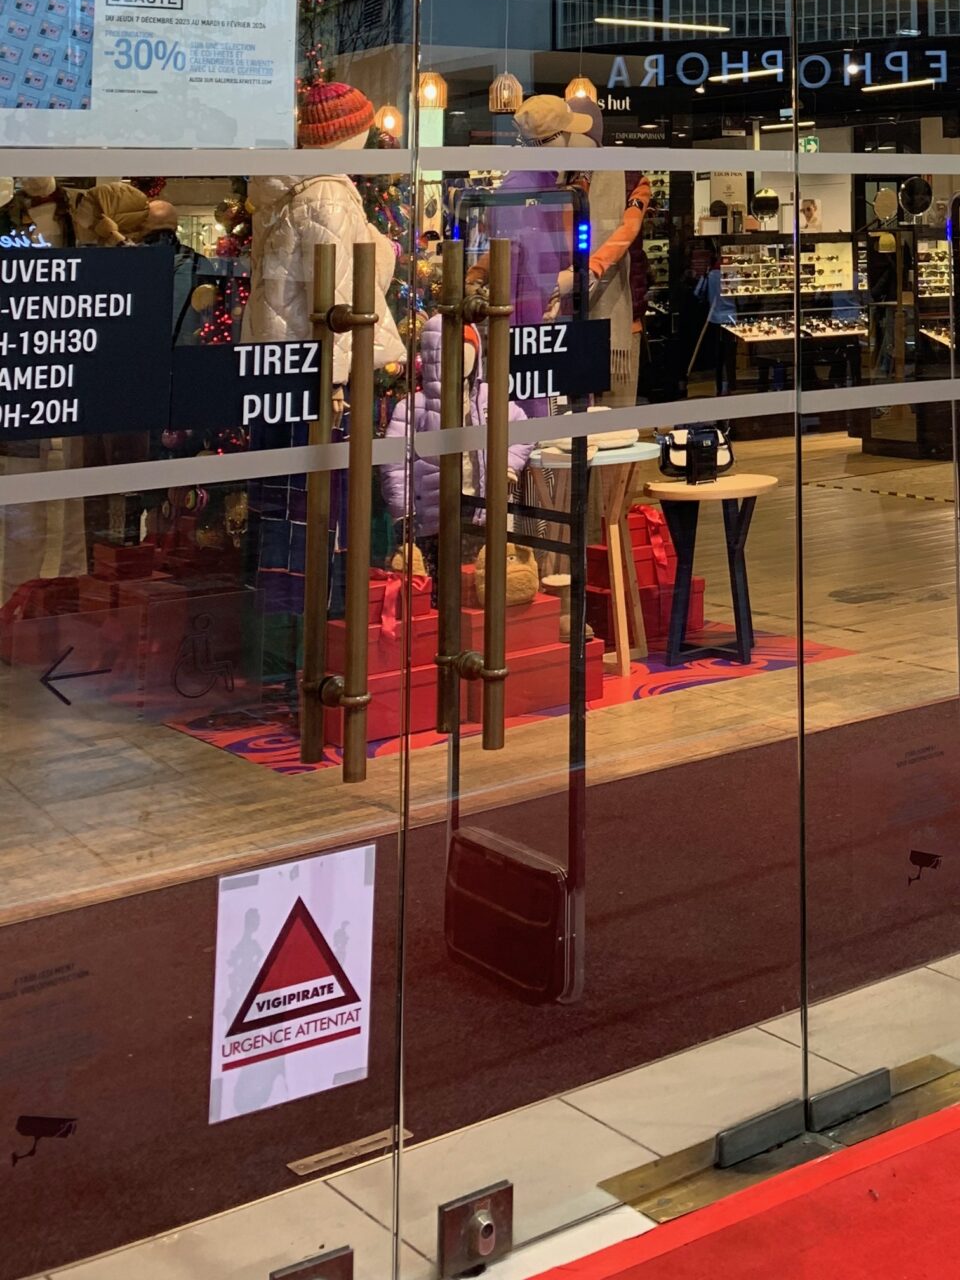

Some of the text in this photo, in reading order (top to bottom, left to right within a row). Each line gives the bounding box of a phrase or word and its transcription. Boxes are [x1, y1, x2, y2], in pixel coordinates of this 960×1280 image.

[116, 14, 134, 23] JEUDI
[104, 38, 187, 72] -30%
[607, 94, 631, 111] hut
[509, 324, 568, 356] IREZ
[233, 342, 319, 377] TIREZ
[0, 398, 79, 429] H-20H
[242, 390, 319, 426] PULL
[255, 982, 335, 1013] VIGIPIRATE
[221, 1007, 362, 1058] URGENCE ATTENTAT
